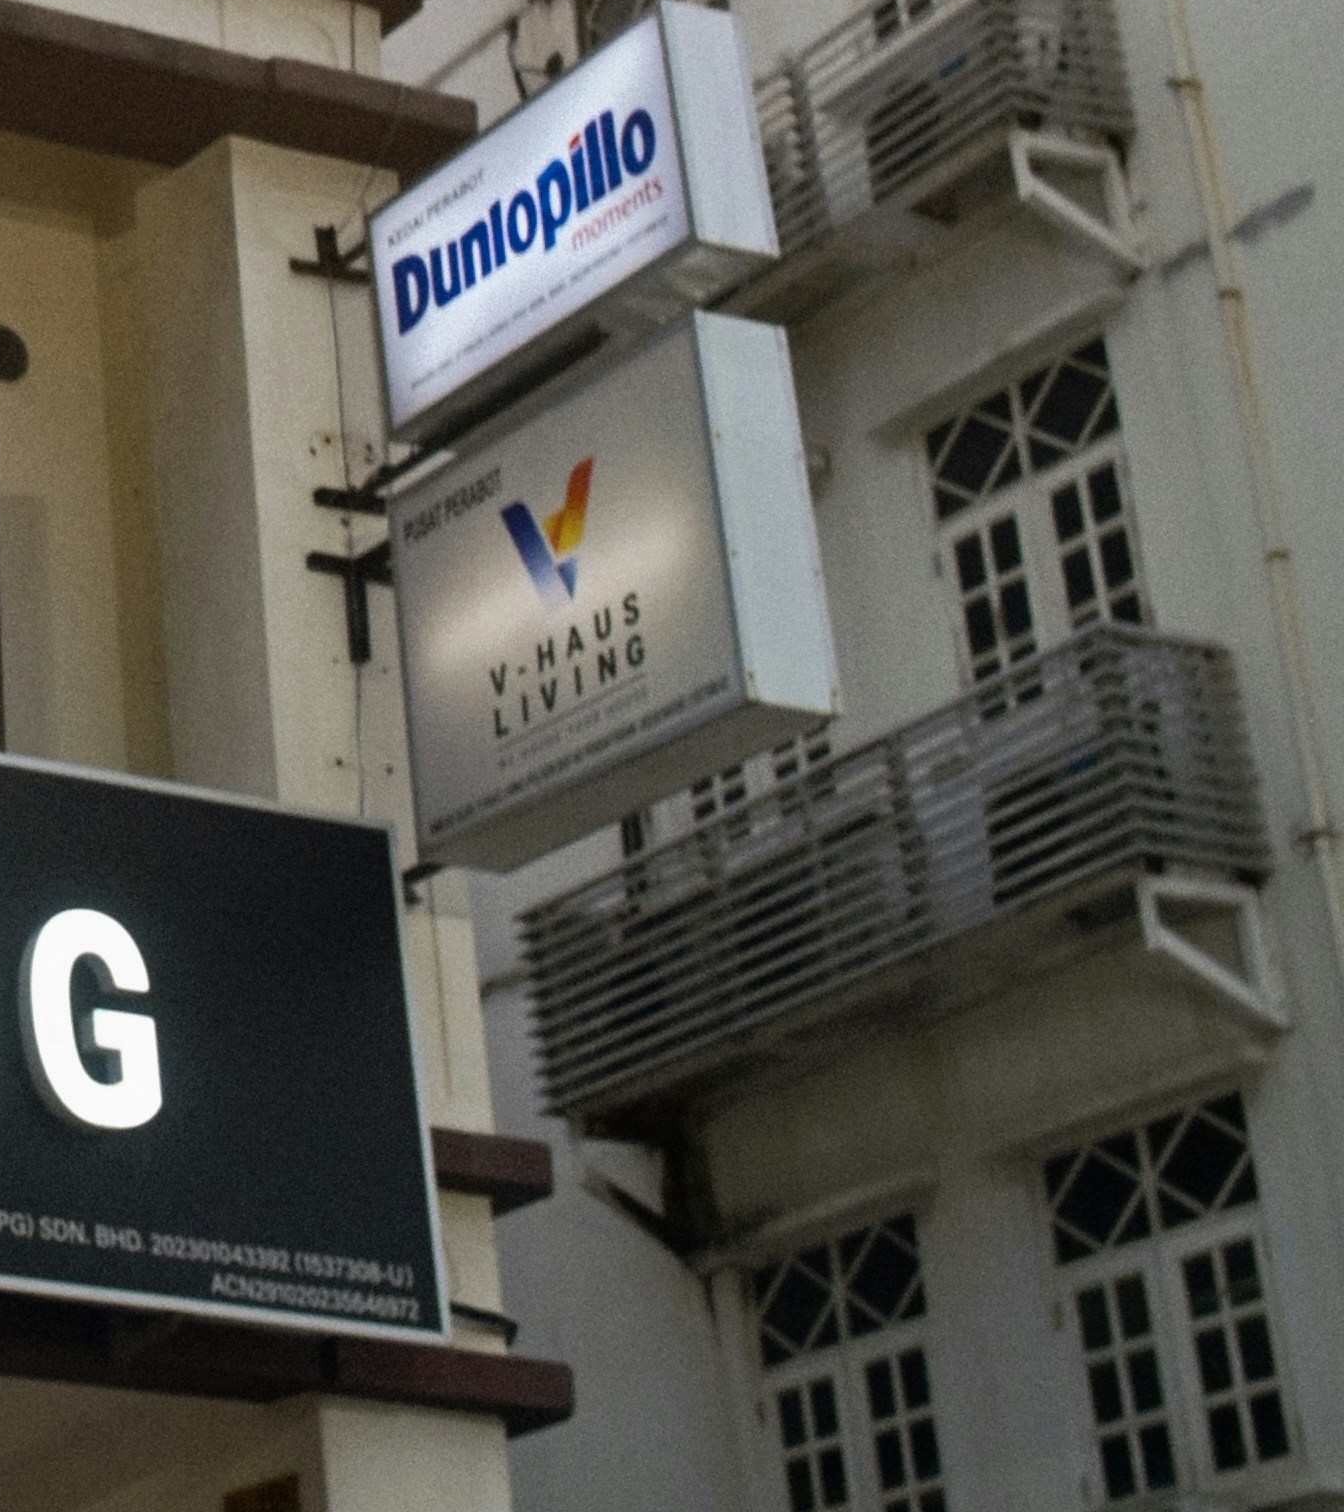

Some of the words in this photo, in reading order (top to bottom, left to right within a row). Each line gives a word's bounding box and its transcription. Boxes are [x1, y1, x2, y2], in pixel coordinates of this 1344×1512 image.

[391, 108, 656, 337] Dunlopillo
[570, 176, 663, 250] moments
[494, 634, 645, 739] LIVING
[39, 1216, 91, 1245] SDN.
[95, 1224, 145, 1253] BHD.
